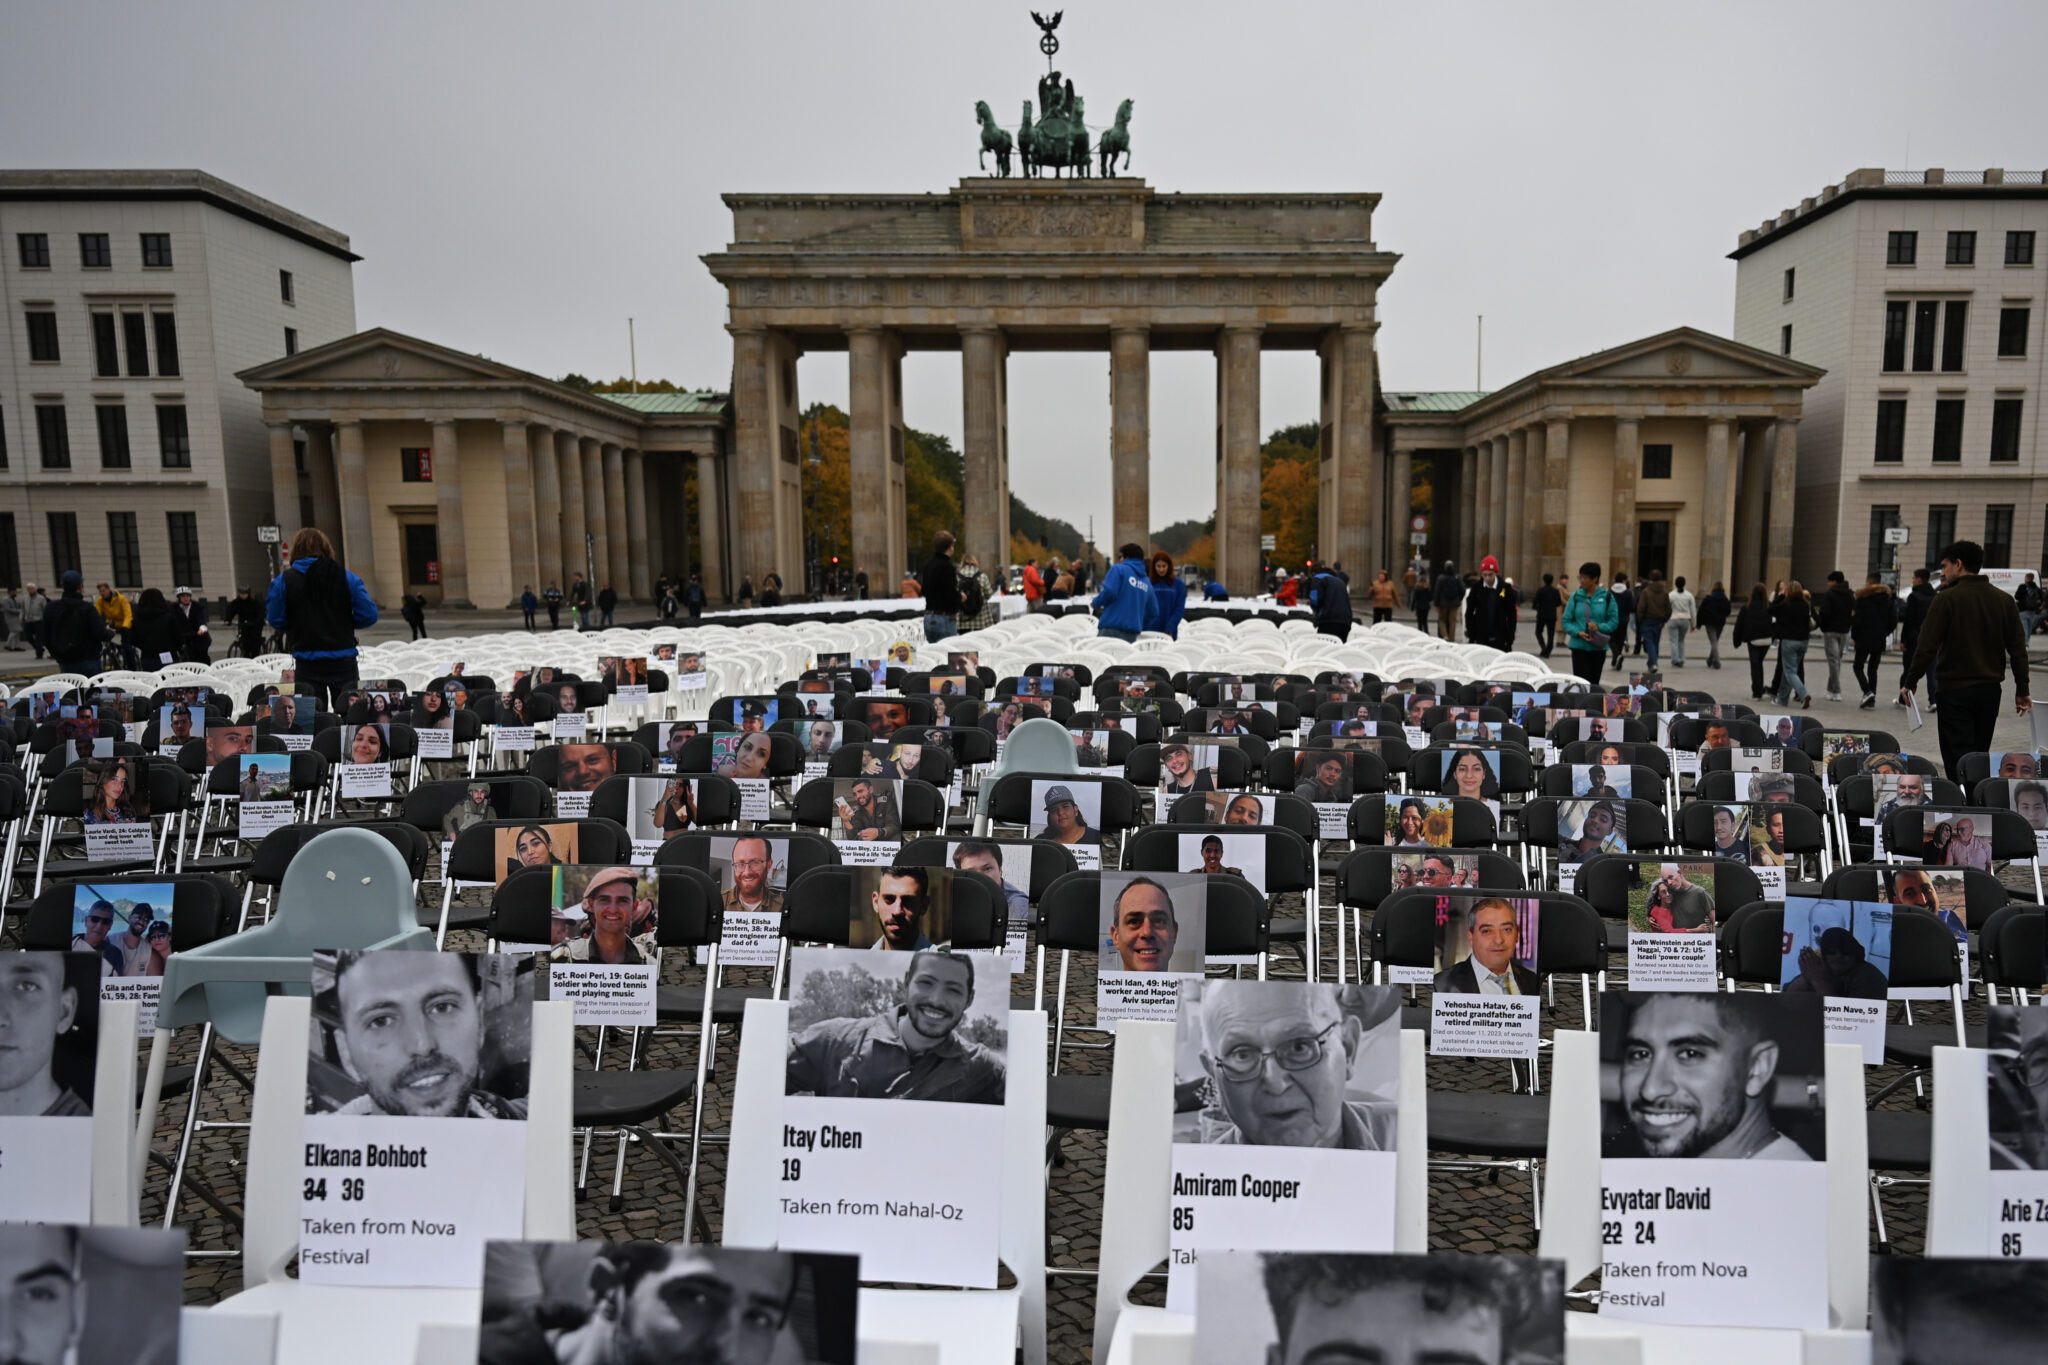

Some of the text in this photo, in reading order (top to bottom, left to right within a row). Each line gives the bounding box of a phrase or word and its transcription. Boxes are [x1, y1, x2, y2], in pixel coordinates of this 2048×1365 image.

[552, 972, 567, 980] Sgt.
[590, 972, 607, 980] Peri,
[624, 972, 649, 980] Golani
[1125, 979, 1144, 987] Idan,
[582, 990, 610, 998] playing
[1122, 996, 1175, 1005] Aviv superfan
[1151, 989, 1178, 997] Hapoel
[1444, 1001, 1481, 1009] Yehoshua
[1483, 1002, 1508, 1010] Hatav,
[1844, 1006, 1865, 1015] Nave,
[1470, 1011, 1515, 1019] grandfather
[1473, 1019, 1502, 1028] military
[784, 1124, 862, 1152] Itay Chen
[305, 1144, 427, 1168] Elkana Bohbot
[782, 1158, 801, 1181] 19
[303, 1178, 364, 1201] 34 36
[1173, 1172, 1300, 1202] Amiram Cooper
[1601, 1187, 1710, 1214] Evyatar David
[780, 1198, 963, 1220] Taken from Nahal-Oz
[2002, 1199, 2031, 1222] Arie
[302, 1218, 456, 1235] Taken from Nova
[1173, 1207, 1194, 1230] 85
[1602, 1221, 1655, 1244] 22 24
[2002, 1233, 2021, 1256] 85
[302, 1249, 369, 1264] Festival
[1602, 1261, 1747, 1277] Taken from Nova
[1600, 1291, 1664, 1307] Festival
